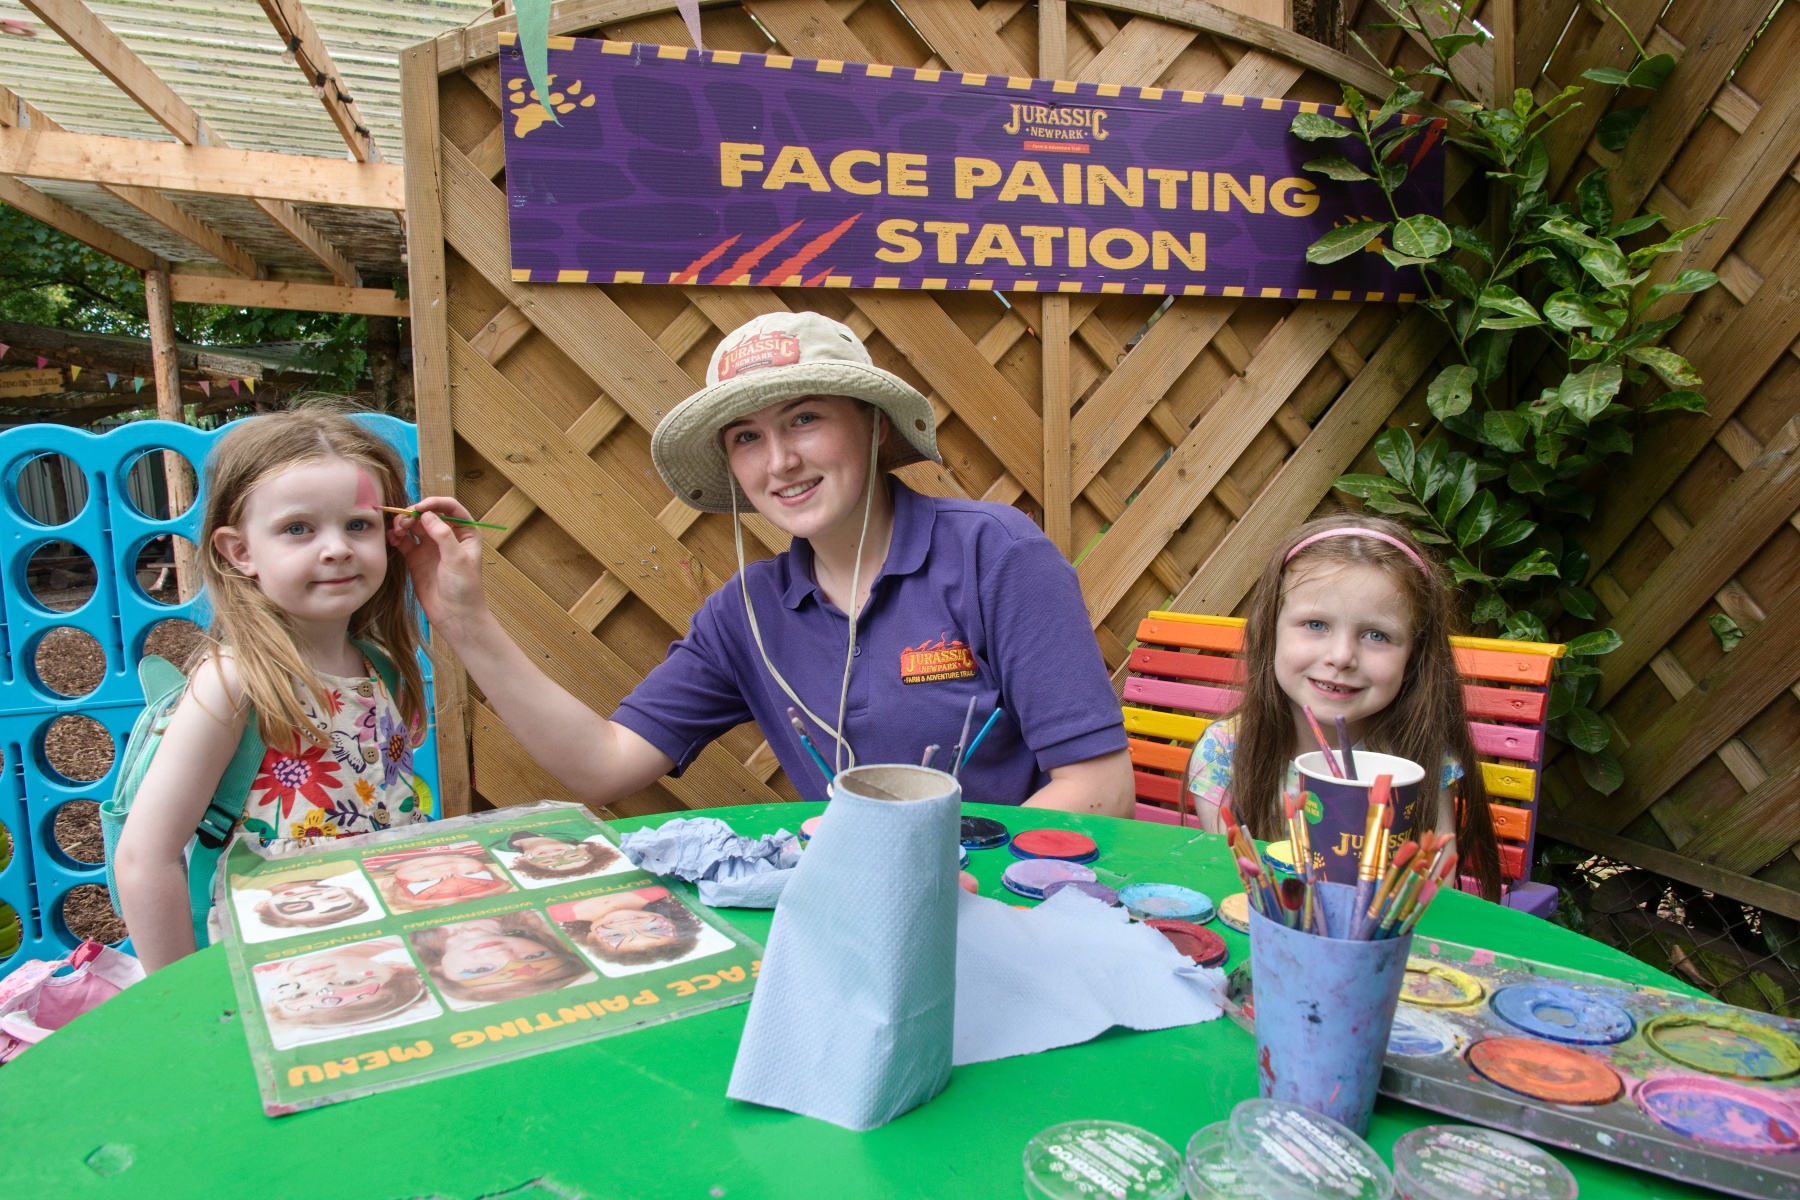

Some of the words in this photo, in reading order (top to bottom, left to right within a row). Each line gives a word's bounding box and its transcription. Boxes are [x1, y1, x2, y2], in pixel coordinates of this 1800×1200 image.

[1003, 104, 1109, 140] JURASSIC
[1030, 126, 1084, 140] NEWPARK
[719, 142, 929, 197] FACE
[954, 156, 1321, 217] PAINTING
[874, 218, 1207, 271] STATION
[721, 339, 795, 377] JURASSIC
[734, 351, 774, 368] NEWPARK
[906, 649, 973, 673] JURASSIC
[921, 662, 957, 673] NEWPARK
[906, 675, 920, 684] FARM
[926, 672, 960, 681] ADVENTURE
[960, 670, 974, 678] TRAIL
[361, 833, 469, 855] SPIDERMAN
[259, 858, 323, 875] PUPPY
[545, 879, 653, 903] BUTTERFLY
[403, 902, 533, 930] WONDERWOMAN
[264, 929, 382, 959] PRINCESS
[450, 989, 660, 1049] PAINTING
[287, 1040, 433, 1088] MENU
